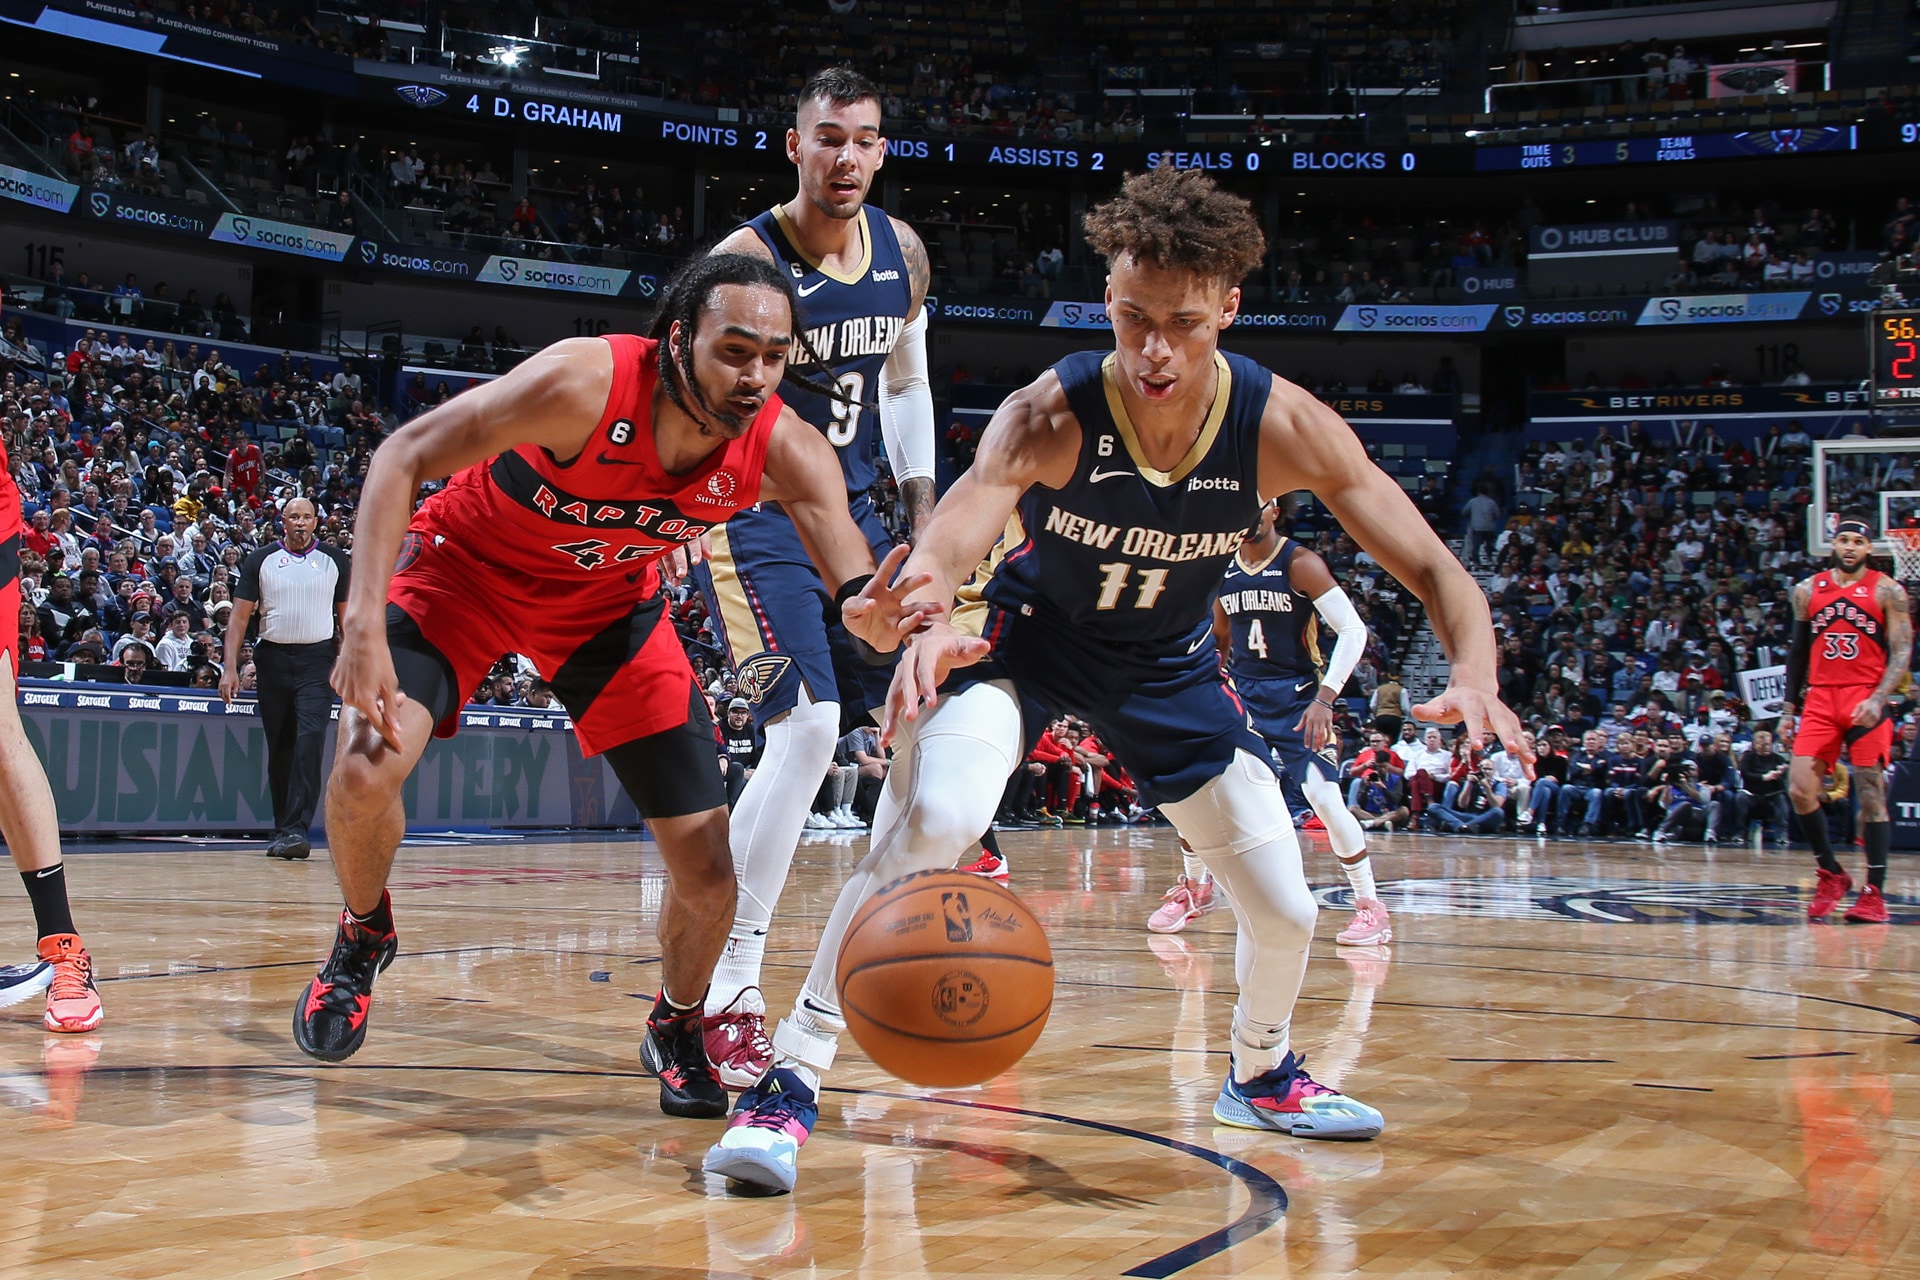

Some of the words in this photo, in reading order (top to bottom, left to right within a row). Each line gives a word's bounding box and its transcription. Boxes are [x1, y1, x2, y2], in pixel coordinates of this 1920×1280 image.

[86, 1, 117, 14] PLAYERS
[118, 7, 136, 18] PASS
[157, 17, 212, 36] PLAYER-FUNDED
[212, 30, 252, 46] COMMUNITY
[253, 39, 280, 51] TICKETS
[440, 73, 470, 85] PLAYERS
[472, 78, 490, 87] PASS
[568, 91, 610, 104] COMMUNITY
[611, 97, 638, 107] TICKETS
[466, 94, 480, 114] 4
[493, 97, 516, 118] D.
[523, 101, 623, 133] GRAHAM
[662, 120, 739, 147] POINTS
[754, 131, 768, 150] 2
[1659, 136, 1692, 149] TEAM
[1901, 123, 1920, 143] 9
[944, 143, 955, 162] 1
[987, 146, 1079, 168] ASSISTS
[1091, 153, 1104, 171] 2
[1521, 144, 1551, 156] TIME
[1562, 146, 1576, 164] 3
[1615, 142, 1629, 161] 5
[1656, 148, 1696, 161] FOULS
[1146, 152, 1233, 170] STEALS
[1245, 152, 1261, 171] 0
[1292, 152, 1386, 170] BLOCKS
[1401, 153, 1416, 171] 0
[1520, 156, 1552, 168] OUTS
[1568, 229, 1612, 245] HUB
[1613, 225, 1669, 242] CLUB
[790, 262, 803, 278] 6
[872, 269, 899, 282] ibotta
[1839, 262, 1874, 275] HUB
[1483, 278, 1515, 290] HUB
[1755, 343, 1799, 376] 118
[1891, 341, 1918, 379] 2
[826, 371, 865, 447] 9
[1609, 393, 1744, 408] BETRIVERS
[612, 422, 631, 444] 6
[1097, 435, 1114, 456] 6
[1187, 476, 1240, 492] ibotta
[695, 493, 716, 505] Sun
[717, 498, 738, 508] Life
[1044, 505, 1121, 550] NEW
[1121, 527, 1250, 562] ORLEANS
[1096, 562, 1170, 610] 11
[1241, 589, 1293, 613] ORLEANS
[1247, 618, 1268, 659] 4
[1822, 632, 1860, 660] 33
[24, 692, 60, 706] SEATGEEK
[77, 694, 111, 708] SEATGEEK
[128, 697, 161, 710] SEATGEEK
[178, 699, 208, 713] SEATGEEK
[225, 703, 255, 715] SEATGEEK
